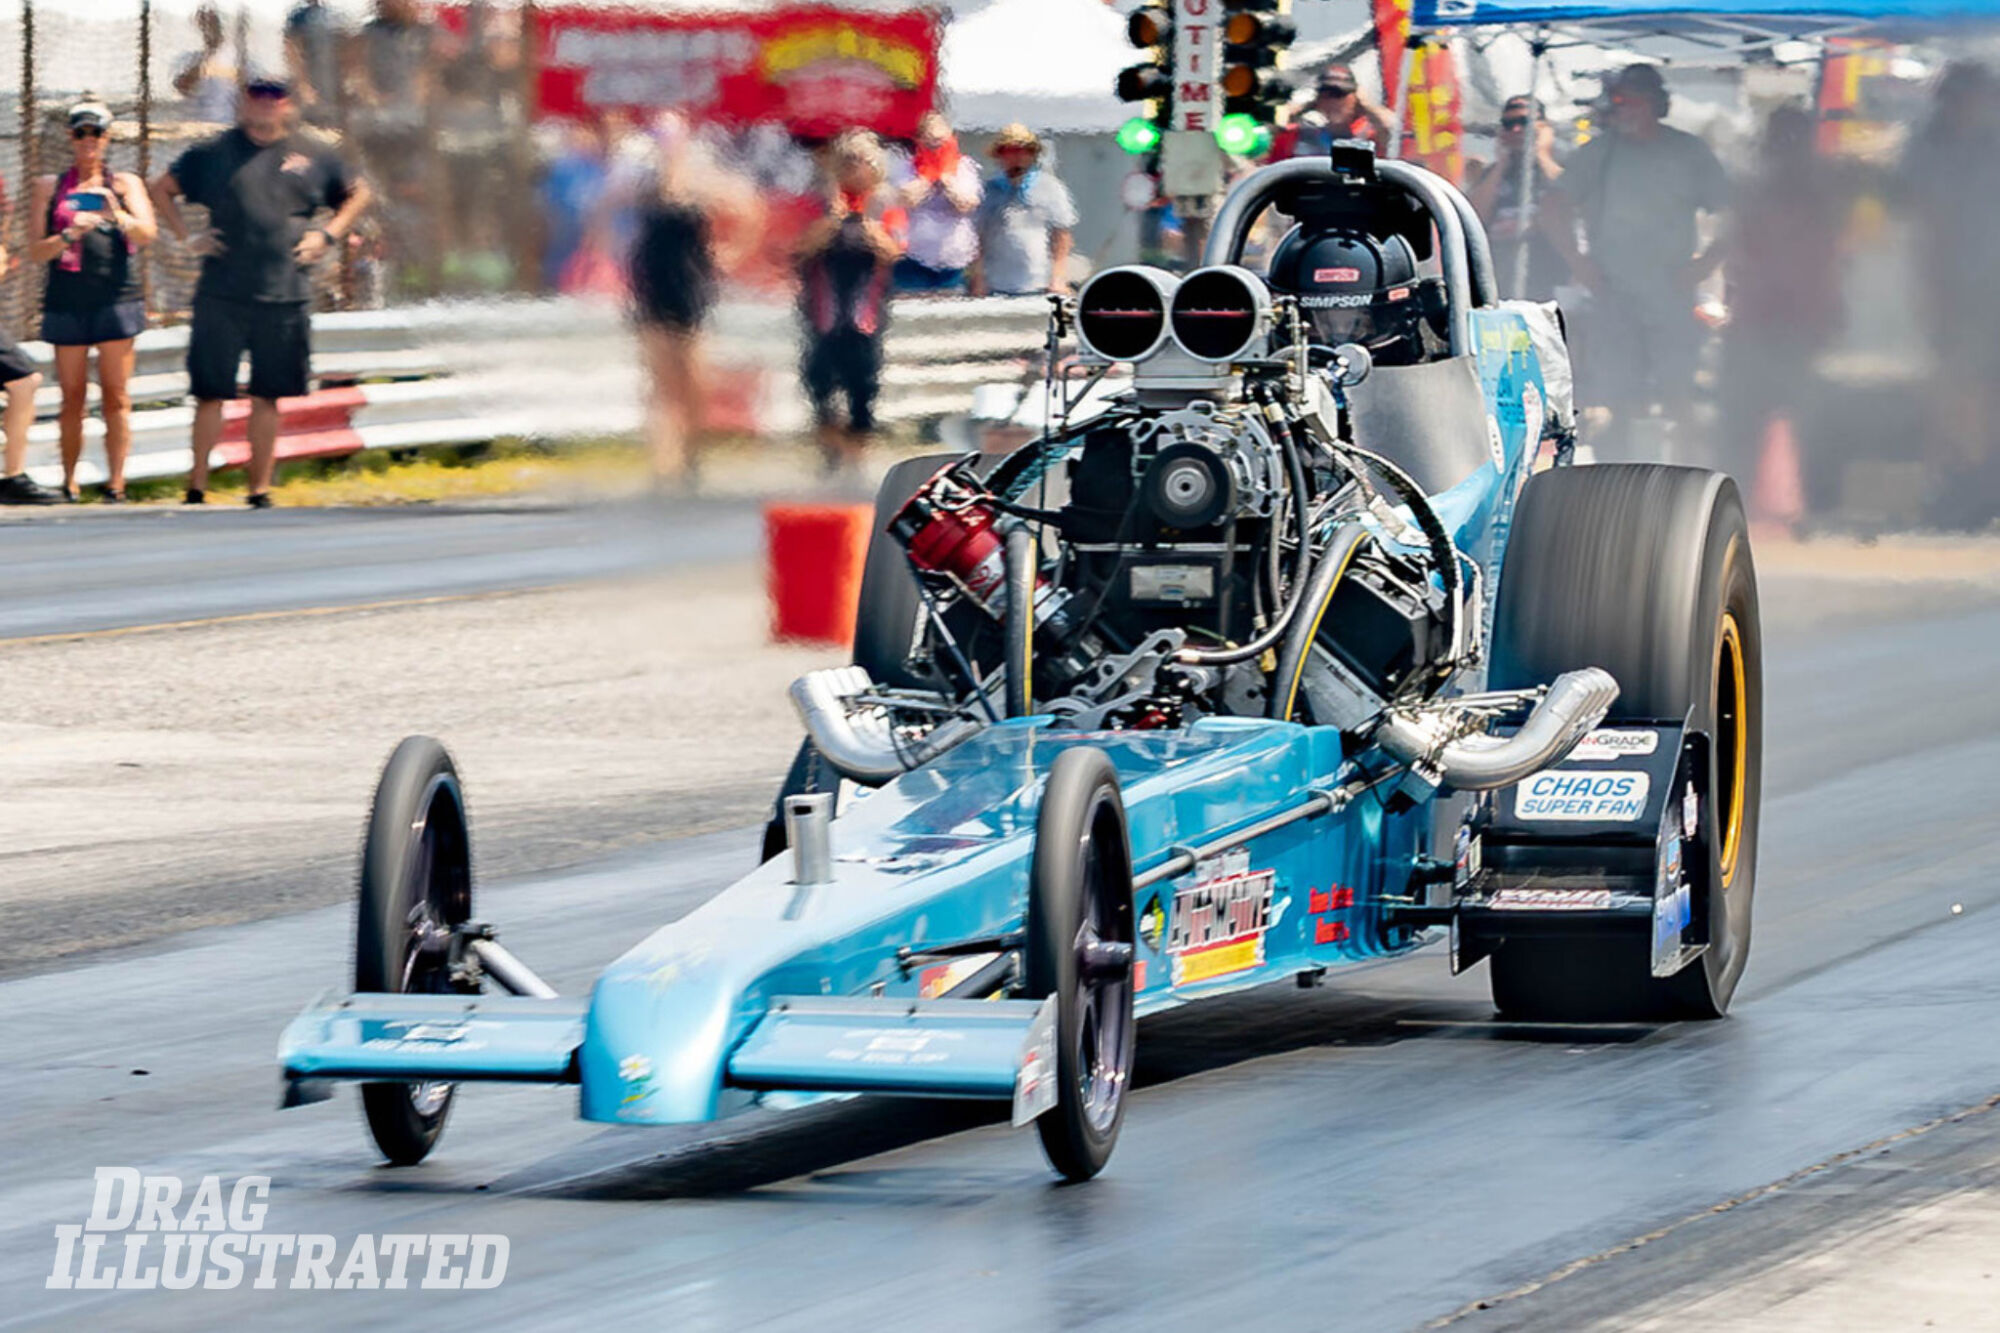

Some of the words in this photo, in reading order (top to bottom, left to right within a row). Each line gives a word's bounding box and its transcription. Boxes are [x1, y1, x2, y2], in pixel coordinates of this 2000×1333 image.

[1299, 294, 1373, 308] SIMPSON
[1532, 777, 1635, 796] CHAOS
[1521, 799, 1593, 814] SUPER
[1594, 799, 1640, 814] FAN
